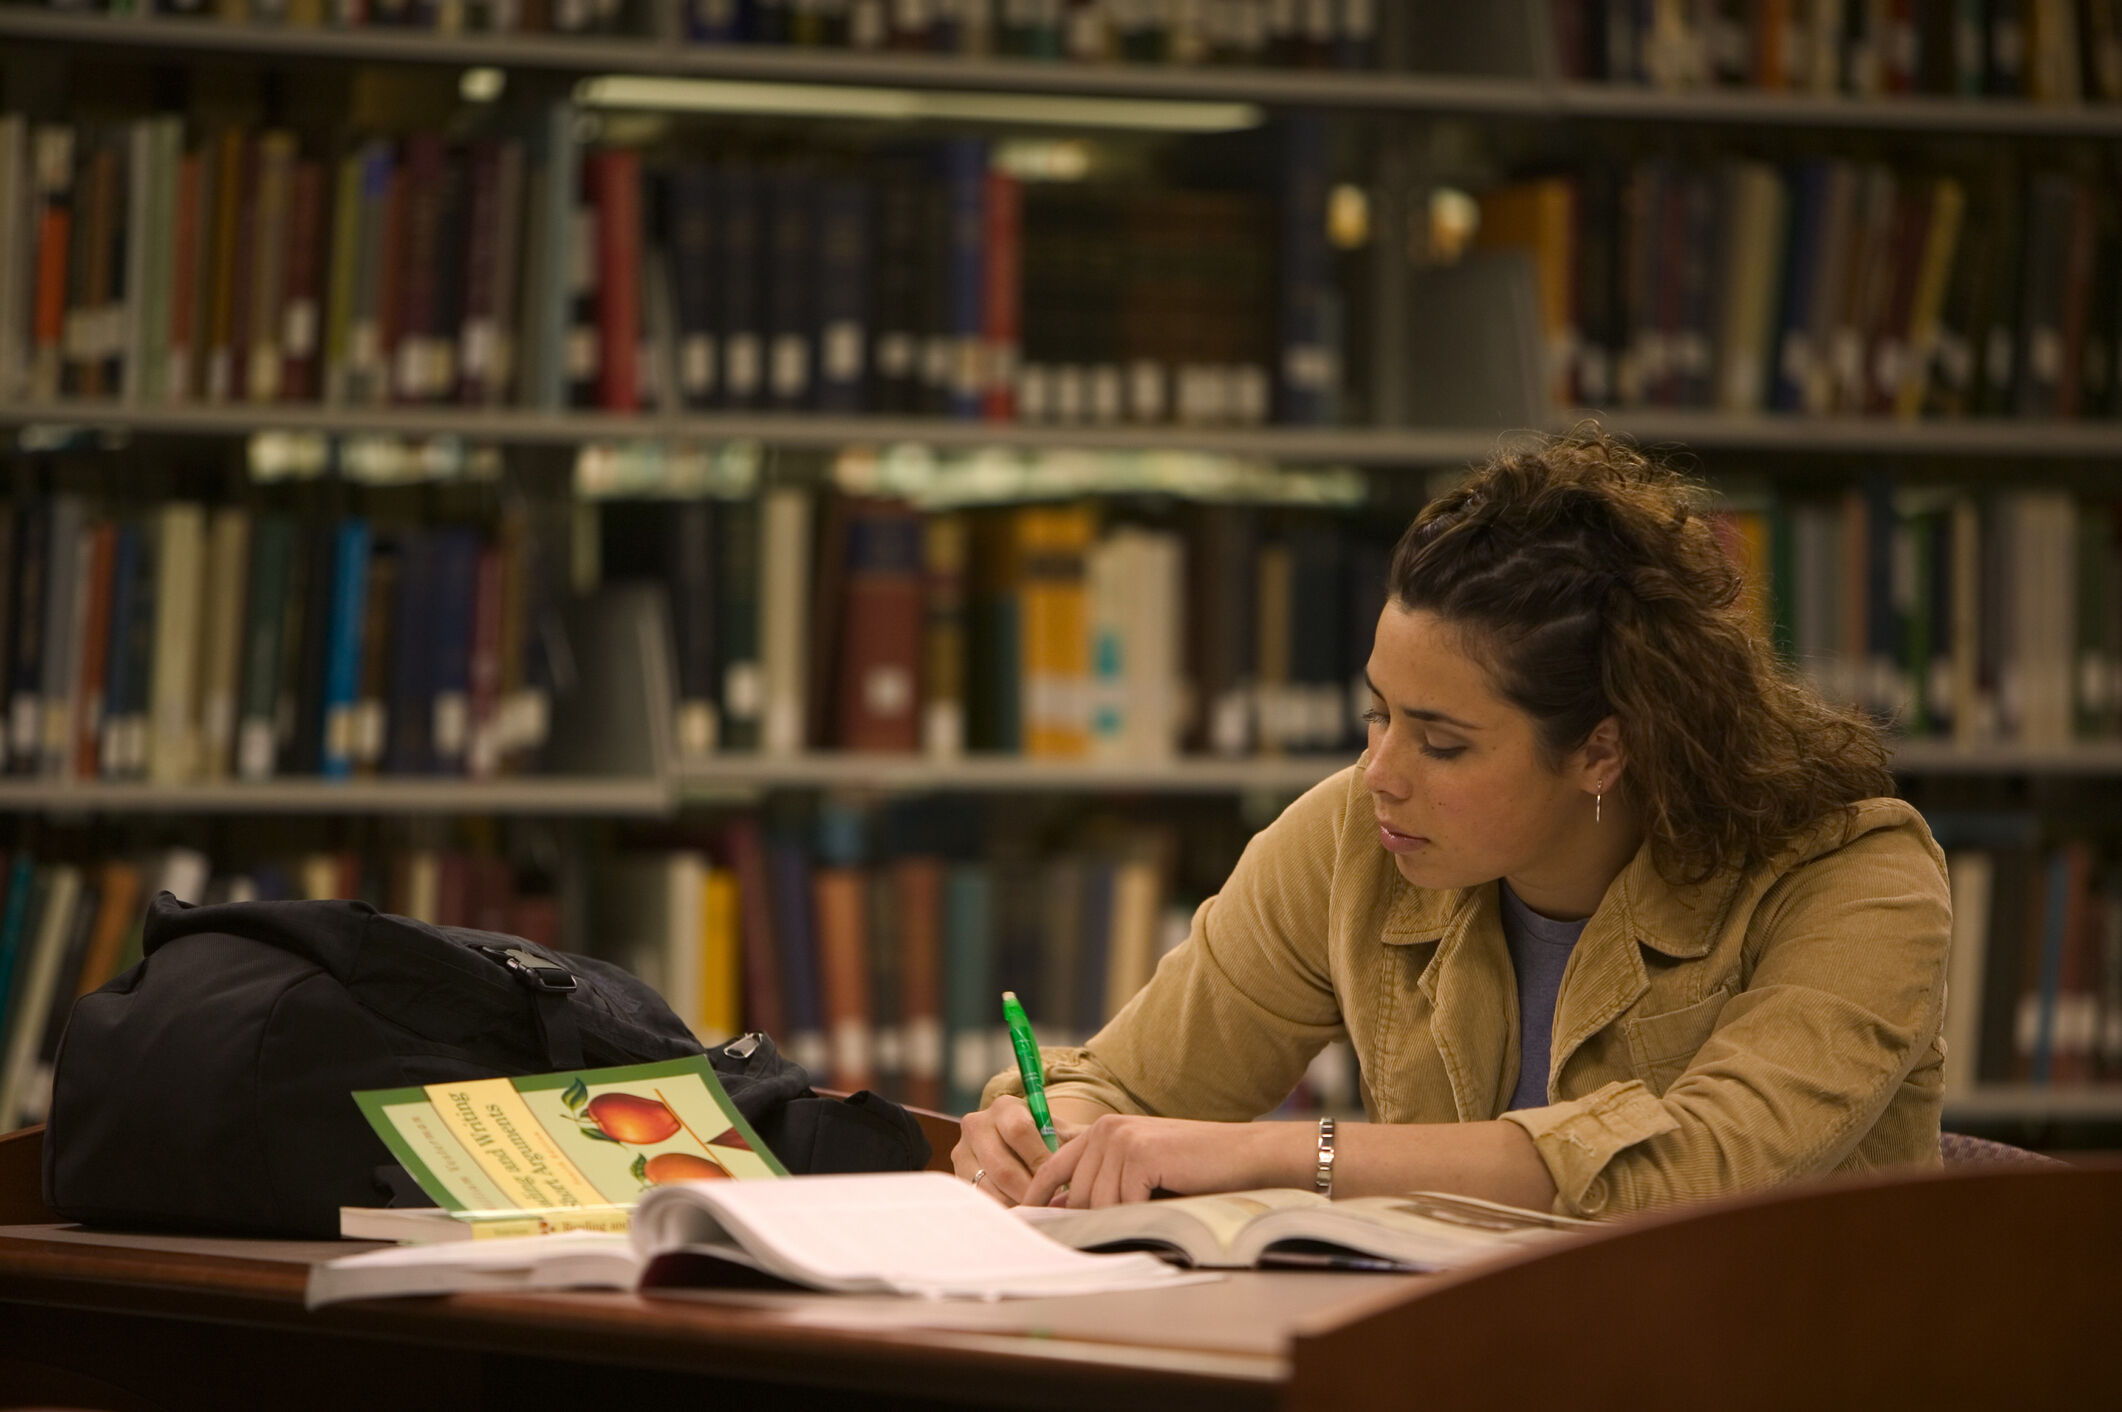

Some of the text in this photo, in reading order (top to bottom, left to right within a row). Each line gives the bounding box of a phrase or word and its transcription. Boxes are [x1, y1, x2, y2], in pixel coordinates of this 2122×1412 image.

[448, 1091, 495, 1148] Writing
[486, 1103, 555, 1175] Arguments
[485, 1147, 521, 1174] and
